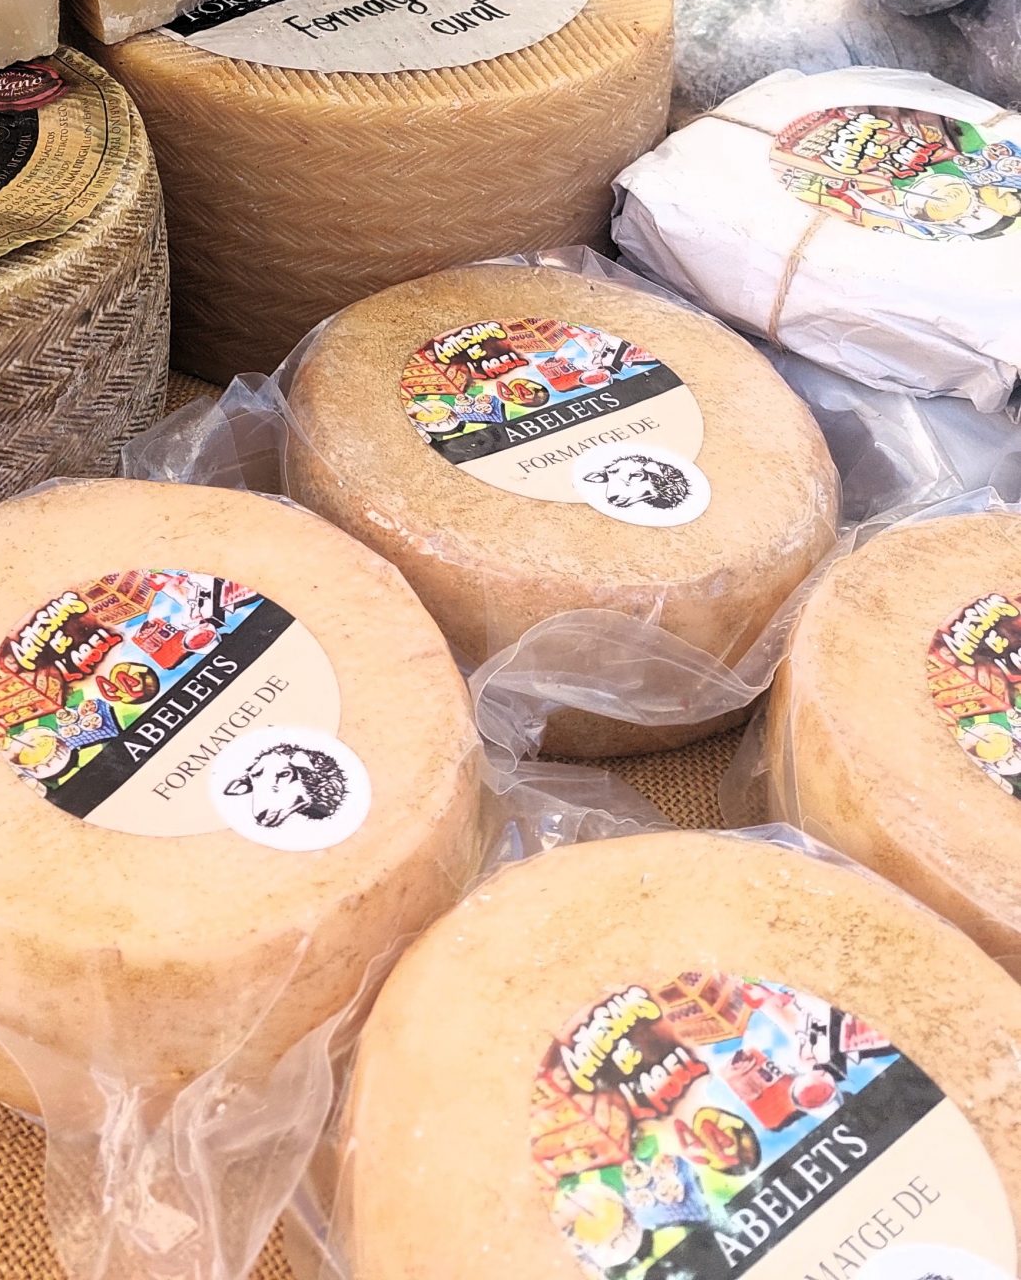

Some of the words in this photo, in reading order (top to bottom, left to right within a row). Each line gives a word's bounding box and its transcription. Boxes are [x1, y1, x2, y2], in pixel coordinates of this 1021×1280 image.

[434, 320, 508, 364] ARTESANS
[466, 352, 529, 380] L'ABEL
[467, 344, 487, 360] DE
[504, 392, 620, 443] ABELETS
[517, 427, 630, 474] FORMATGE
[627, 416, 660, 435] DE
[9, 591, 89, 670] ARTESANS
[49, 630, 73, 654] DE
[54, 628, 123, 681] L'ABEL
[941, 593, 1020, 666] ARTESANS
[984, 629, 1009, 654] DE
[123, 655, 238, 762] ABELETS
[152, 701, 263, 801] FORMATGE
[253, 675, 290, 704] DE
[560, 985, 661, 1093] ARTESANS
[611, 1038, 643, 1075] DE
[618, 1046, 709, 1119] L'ABEL
[713, 1123, 869, 1269] ABELETS
[891, 1175, 942, 1220] DE
